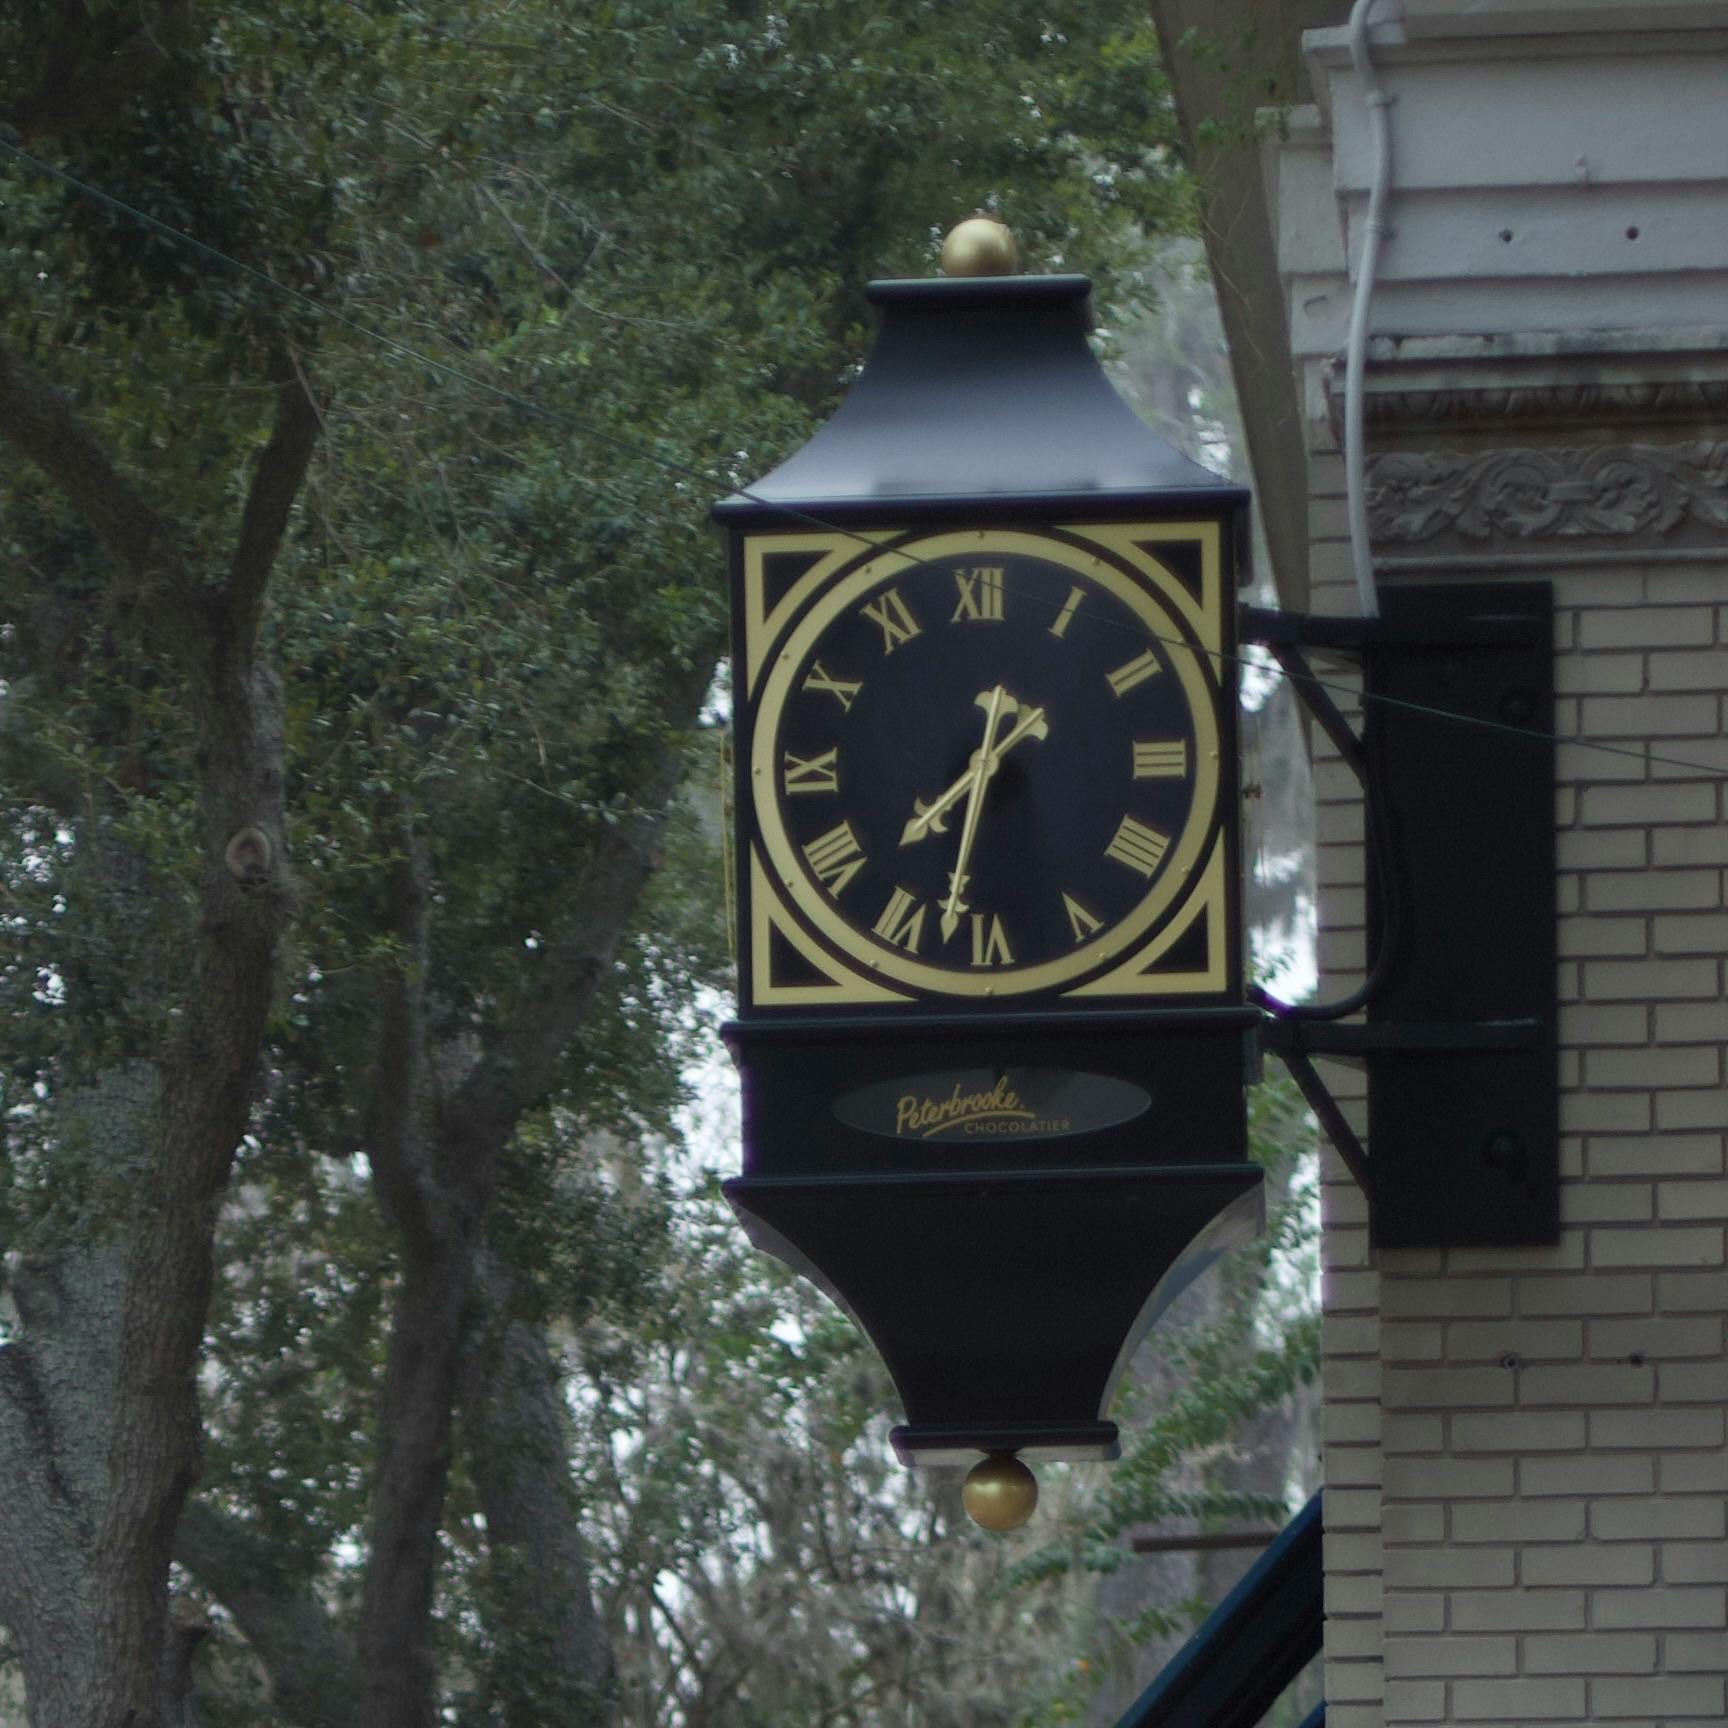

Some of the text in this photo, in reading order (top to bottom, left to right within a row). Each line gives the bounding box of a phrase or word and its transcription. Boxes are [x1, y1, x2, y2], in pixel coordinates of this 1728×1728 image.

[951, 567, 1004, 622] XII
[1049, 586, 1087, 638] I
[860, 587, 922, 655] XI
[802, 660, 862, 711] X
[1106, 649, 1162, 697] II
[784, 747, 838, 795] IX
[1133, 739, 1186, 780] III
[802, 820, 868, 900] VIII
[1104, 814, 1170, 879] IIII
[871, 885, 928, 954] VII
[970, 914, 1015, 966] VI
[1061, 892, 1104, 942] V
[964, 1119, 1071, 1134] CHOCOLATIER
